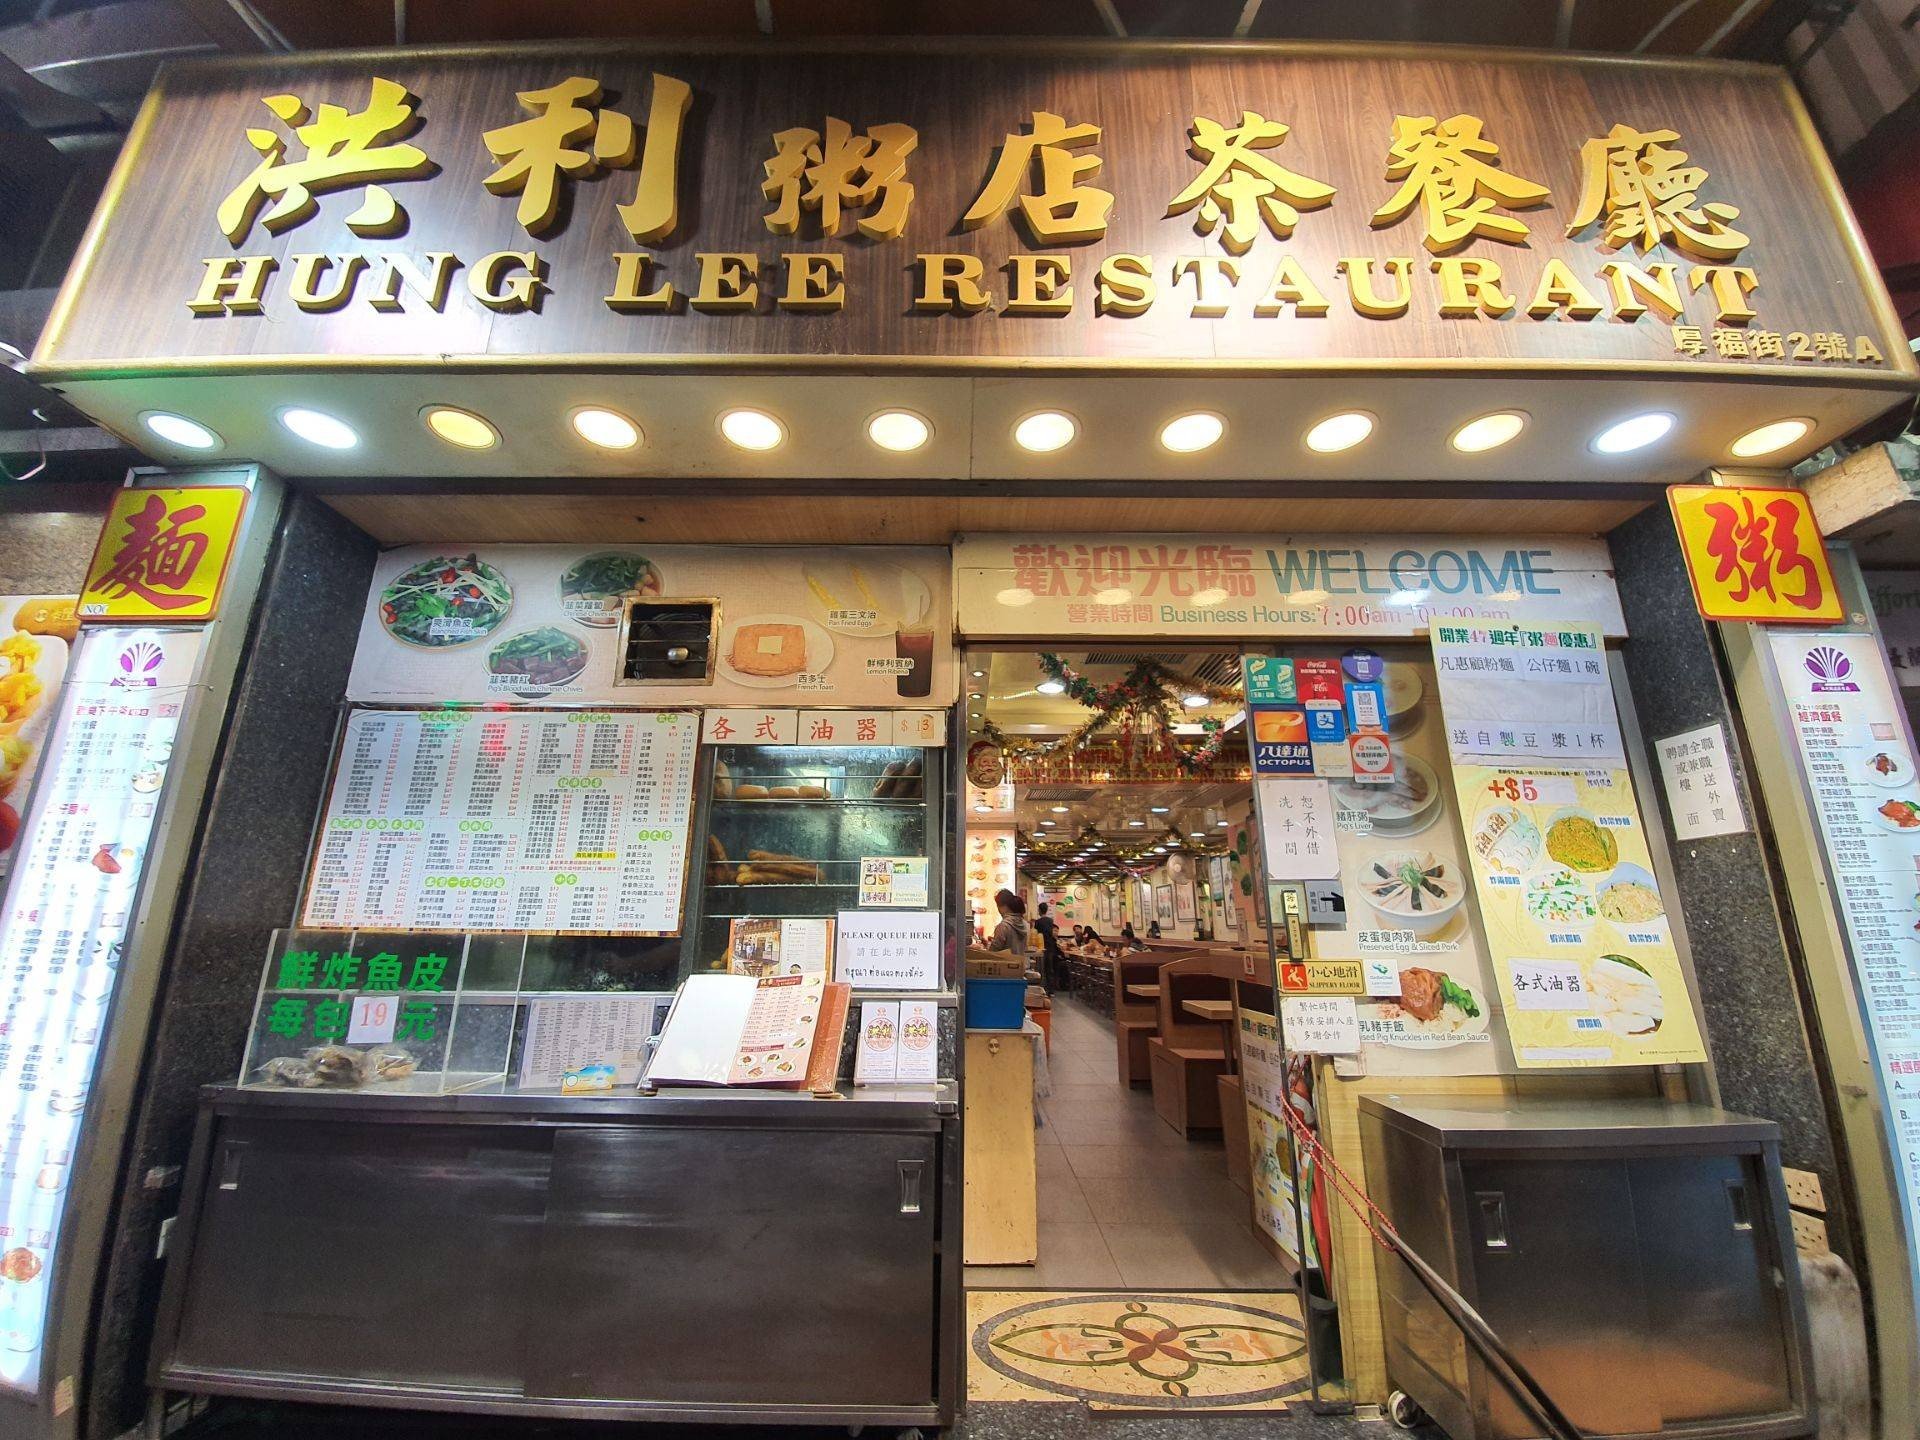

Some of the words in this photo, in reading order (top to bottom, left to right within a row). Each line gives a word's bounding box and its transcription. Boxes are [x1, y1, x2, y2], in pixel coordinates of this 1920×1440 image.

[215, 73, 1750, 260] 洪利粥店茶餐廳
[185, 250, 546, 316] HUNG
[603, 250, 847, 312] LEE
[913, 252, 1760, 324] RESTAURANT
[1670, 326, 1884, 363] 厚福街2號A
[89, 494, 209, 610] 麵
[1704, 496, 1823, 611] 粥
[1012, 544, 1256, 597] 歡迎光臨
[1266, 549, 1561, 596] WELCOME
[1067, 603, 1153, 624] 營業時間
[1160, 605, 1248, 624] Business
[1253, 606, 1317, 624] Hours:
[798, 675, 826, 683] 西多士
[710, 715, 877, 741] 各式油器
[1259, 746, 1310, 757] 八達通
[1279, 796, 1297, 856] 洗手間
[1301, 795, 1320, 855] 恕不外借
[1337, 822, 1352, 831] Pig's
[841, 931, 875, 940] PLEASE
[876, 931, 908, 941] QUEUE
[909, 931, 934, 940] HERE
[1358, 932, 1415, 943] 皮蛋瘦肉粥
[857, 947, 918, 957] 請在此排隊
[1359, 943, 1394, 951] Preserved
[1396, 943, 1409, 952] Egg
[1419, 943, 1440, 951] Sliced
[1442, 943, 1458, 951] Pork
[275, 951, 449, 993] 鮮炸魚皮
[1307, 966, 1358, 978] 小心地滑
[1514, 975, 1580, 992] 各式油器
[267, 997, 350, 1040] 每包
[360, 1004, 388, 1028] 19
[396, 1001, 439, 1041] 元
[1360, 1021, 1404, 1031] 乳豬手飯
[1376, 1033, 1388, 1042] Pig
[1390, 1033, 1421, 1041] Knuckles
